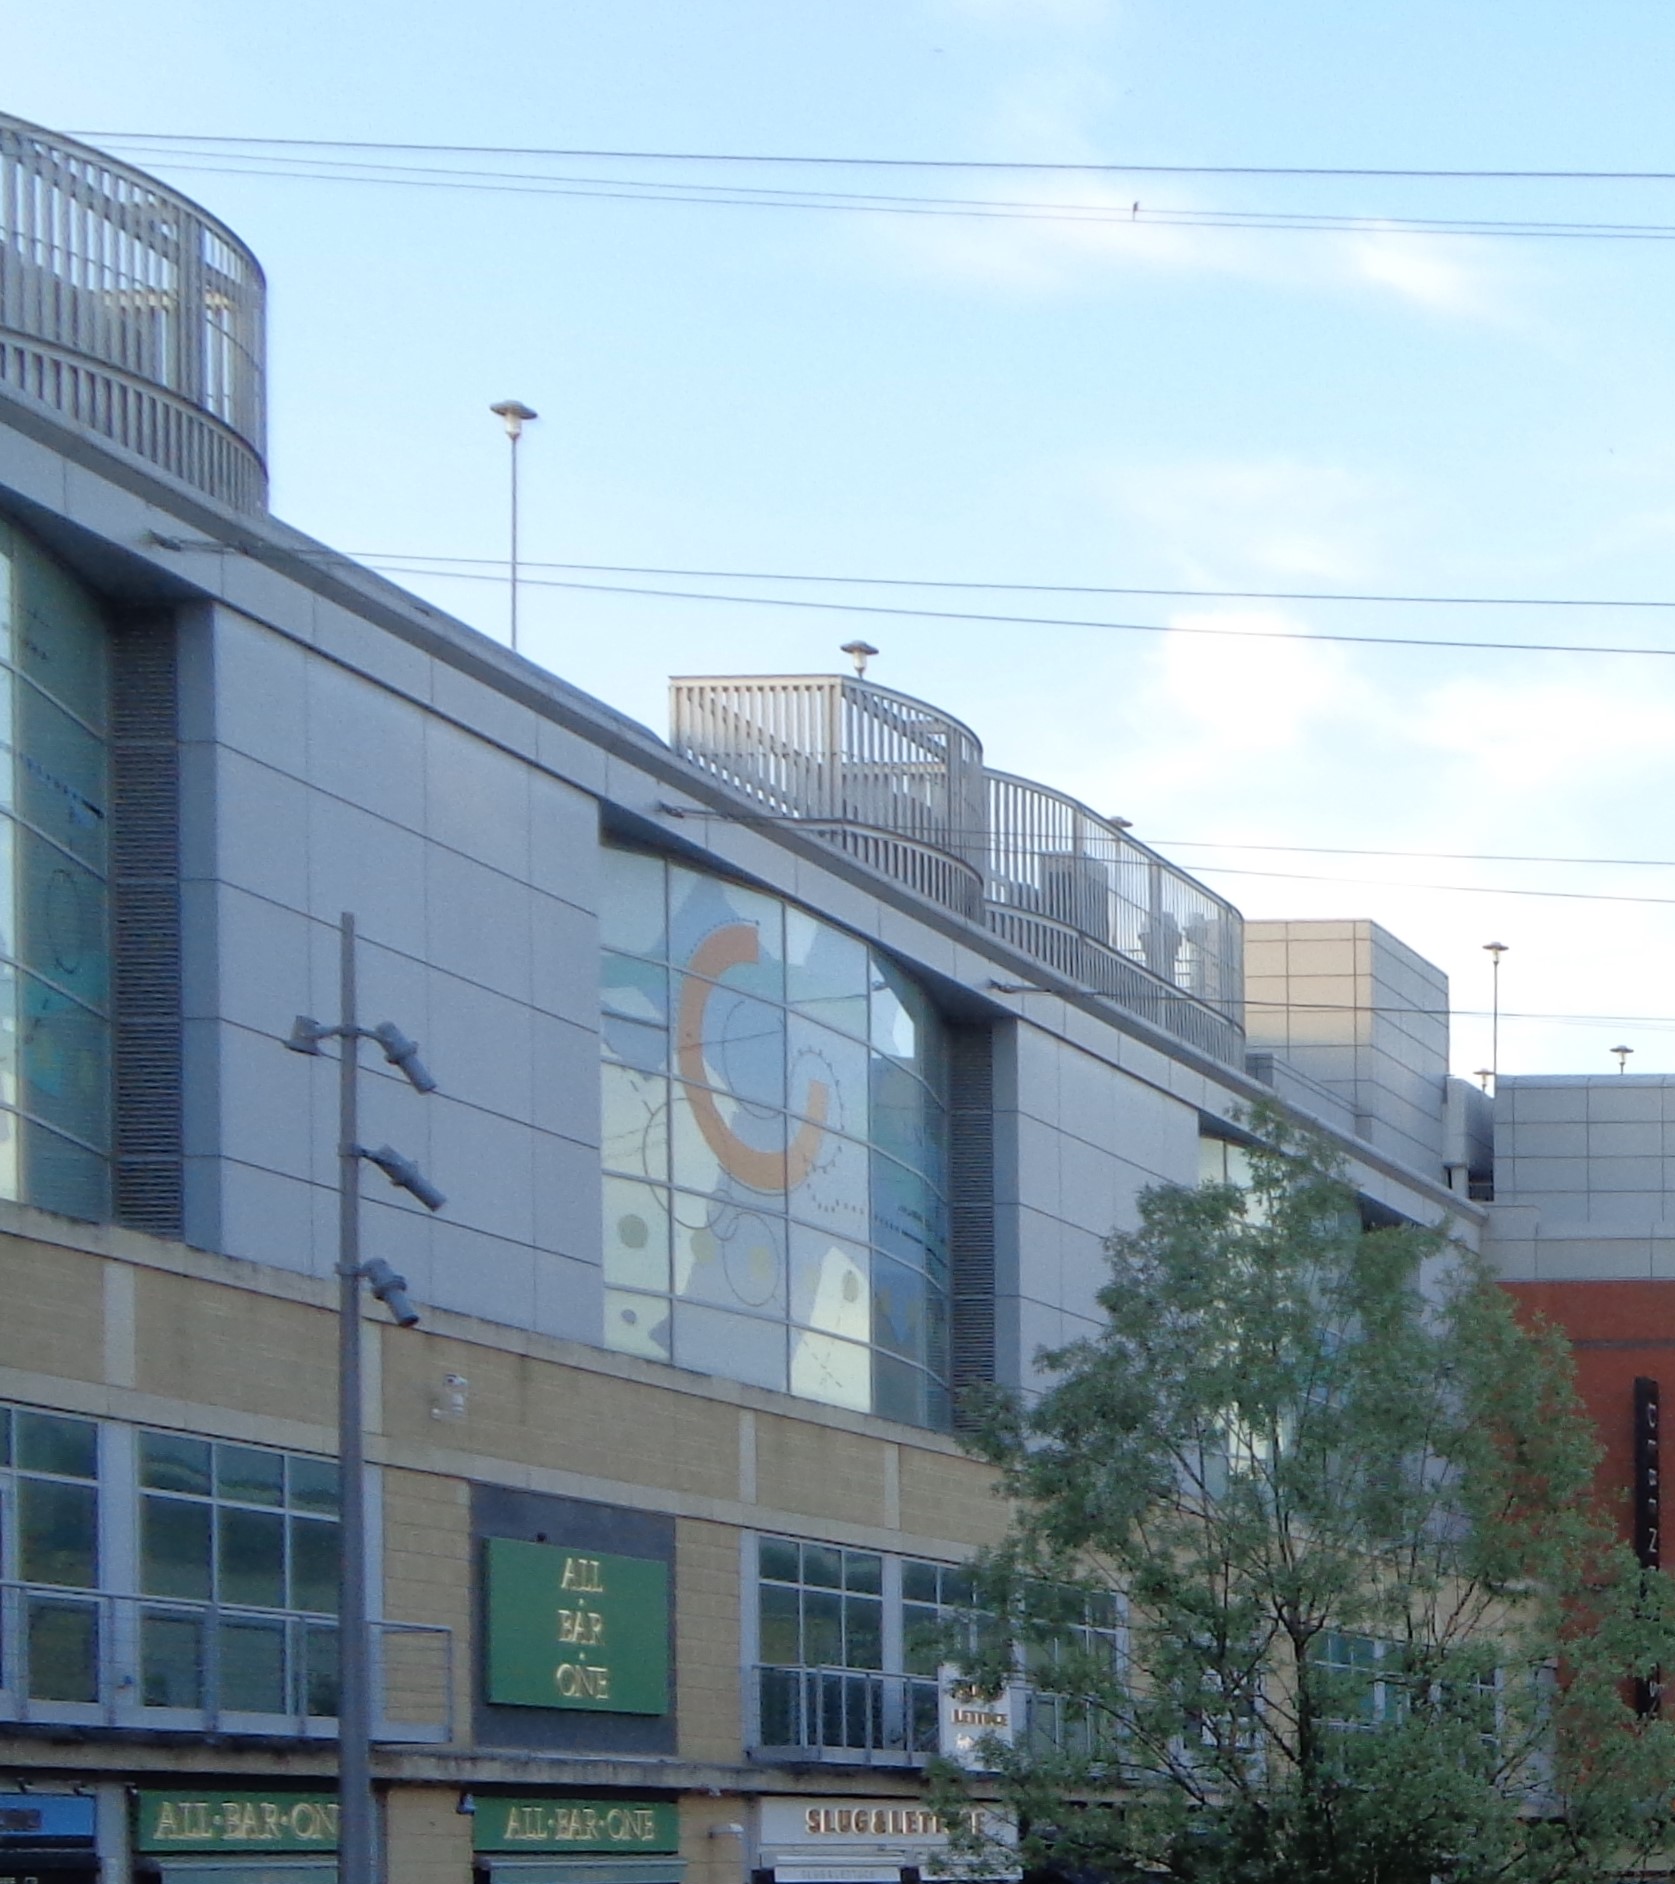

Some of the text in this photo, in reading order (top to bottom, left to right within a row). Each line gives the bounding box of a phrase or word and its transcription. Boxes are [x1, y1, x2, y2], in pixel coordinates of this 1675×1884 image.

[561, 1557, 603, 1592] ALL
[558, 1609, 604, 1646] BAR
[556, 1663, 609, 1699] ONE
[153, 1801, 340, 1840] ALL BAR ON
[504, 1806, 656, 1842] ALL BAR ONE
